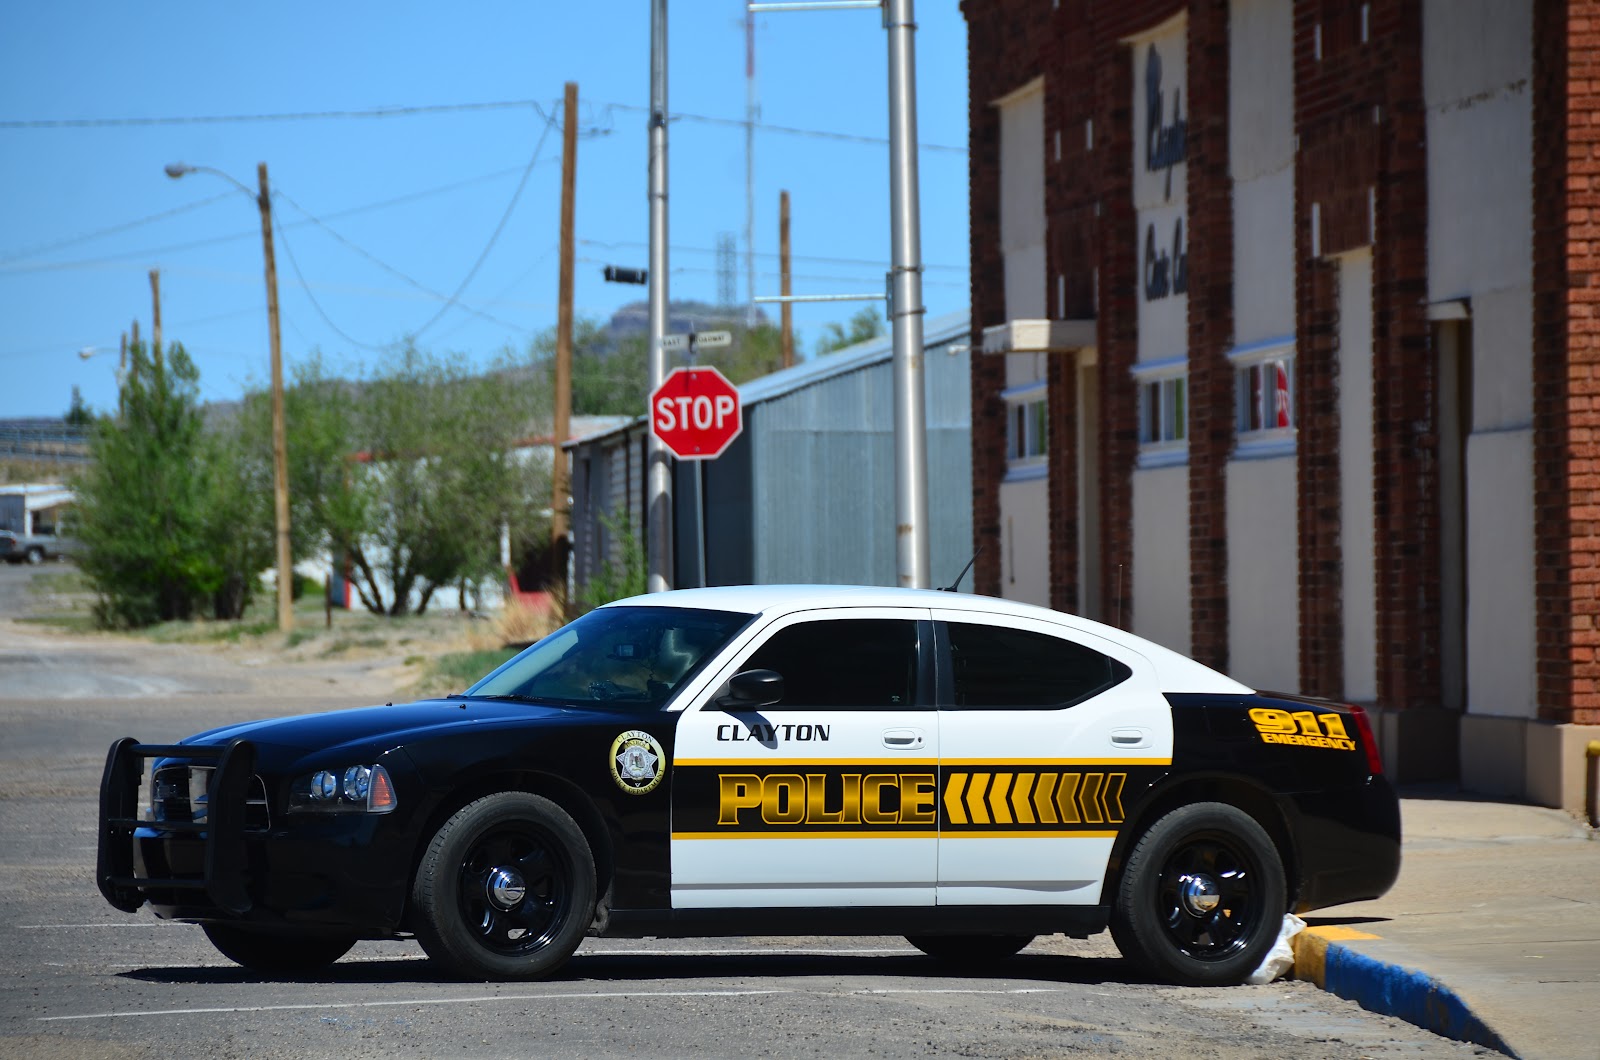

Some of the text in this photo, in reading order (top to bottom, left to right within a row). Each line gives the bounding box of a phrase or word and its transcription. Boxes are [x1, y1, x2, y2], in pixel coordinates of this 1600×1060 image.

[656, 395, 735, 432] STOP
[716, 724, 831, 742] CLAYTON
[1248, 708, 1350, 739] 911
[616, 731, 654, 744] CLAYTON
[1260, 733, 1356, 751] EMERGENCY
[610, 767, 664, 794] POLICE DEPARTMENT
[717, 774, 936, 824] POLICE
